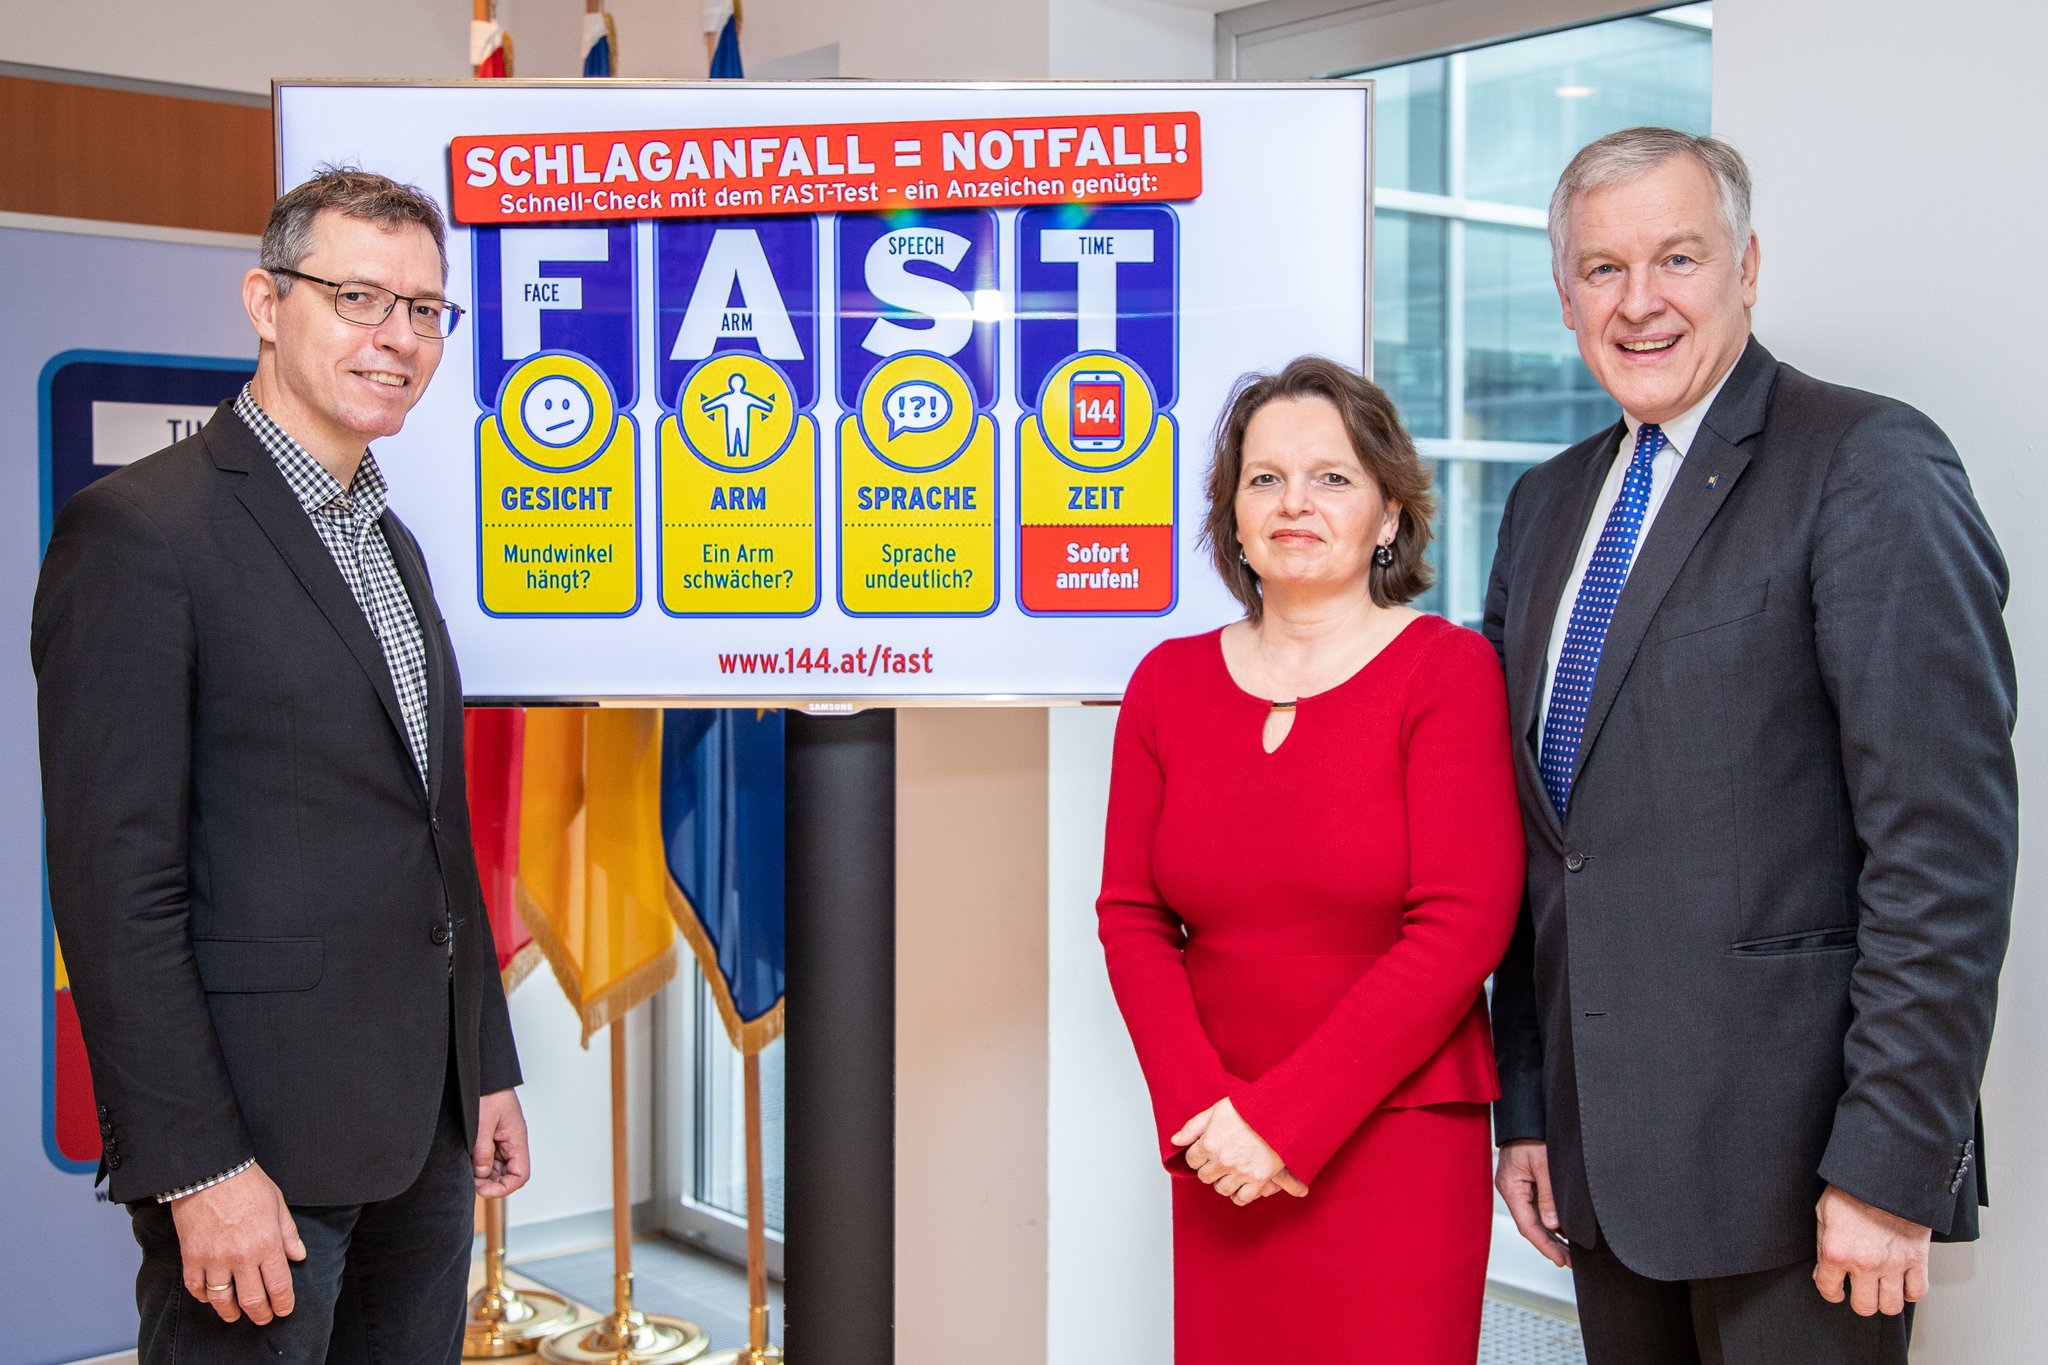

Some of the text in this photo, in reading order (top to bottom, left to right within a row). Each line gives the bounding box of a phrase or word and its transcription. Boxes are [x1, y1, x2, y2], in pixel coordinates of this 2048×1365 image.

[465, 123, 1188, 188] SCHLAGANFALL = NOTFALL!
[500, 188, 663, 215] Schnell-Check
[670, 186, 707, 209] mit
[714, 185, 763, 207] dem
[770, 181, 879, 205] FAST-Test
[904, 180, 939, 200] ein
[947, 176, 1065, 199] Anzeichen
[1071, 173, 1158, 198] genügt:
[888, 236, 944, 255] SPEECH
[1079, 236, 1114, 255] TIME
[524, 283, 560, 302] FACE
[721, 312, 753, 331] ARM
[1075, 398, 1117, 424] 144
[501, 486, 612, 510] GESICHT
[710, 486, 767, 510] ARM
[858, 486, 977, 510] SPRACHE
[1068, 486, 1125, 509] ZEIT
[504, 544, 613, 563] Mundwinkel
[703, 544, 774, 563] Ein Arm
[882, 543, 956, 567] Sprache
[1066, 542, 1130, 563] Sofort
[527, 569, 591, 593] hängt?
[683, 569, 793, 589] schwächer?
[865, 569, 973, 589] undeutlich?
[1056, 567, 1139, 589] anrufen!
[718, 644, 933, 677] www.144.at/fast
[808, 703, 853, 711] SAMSUNG
